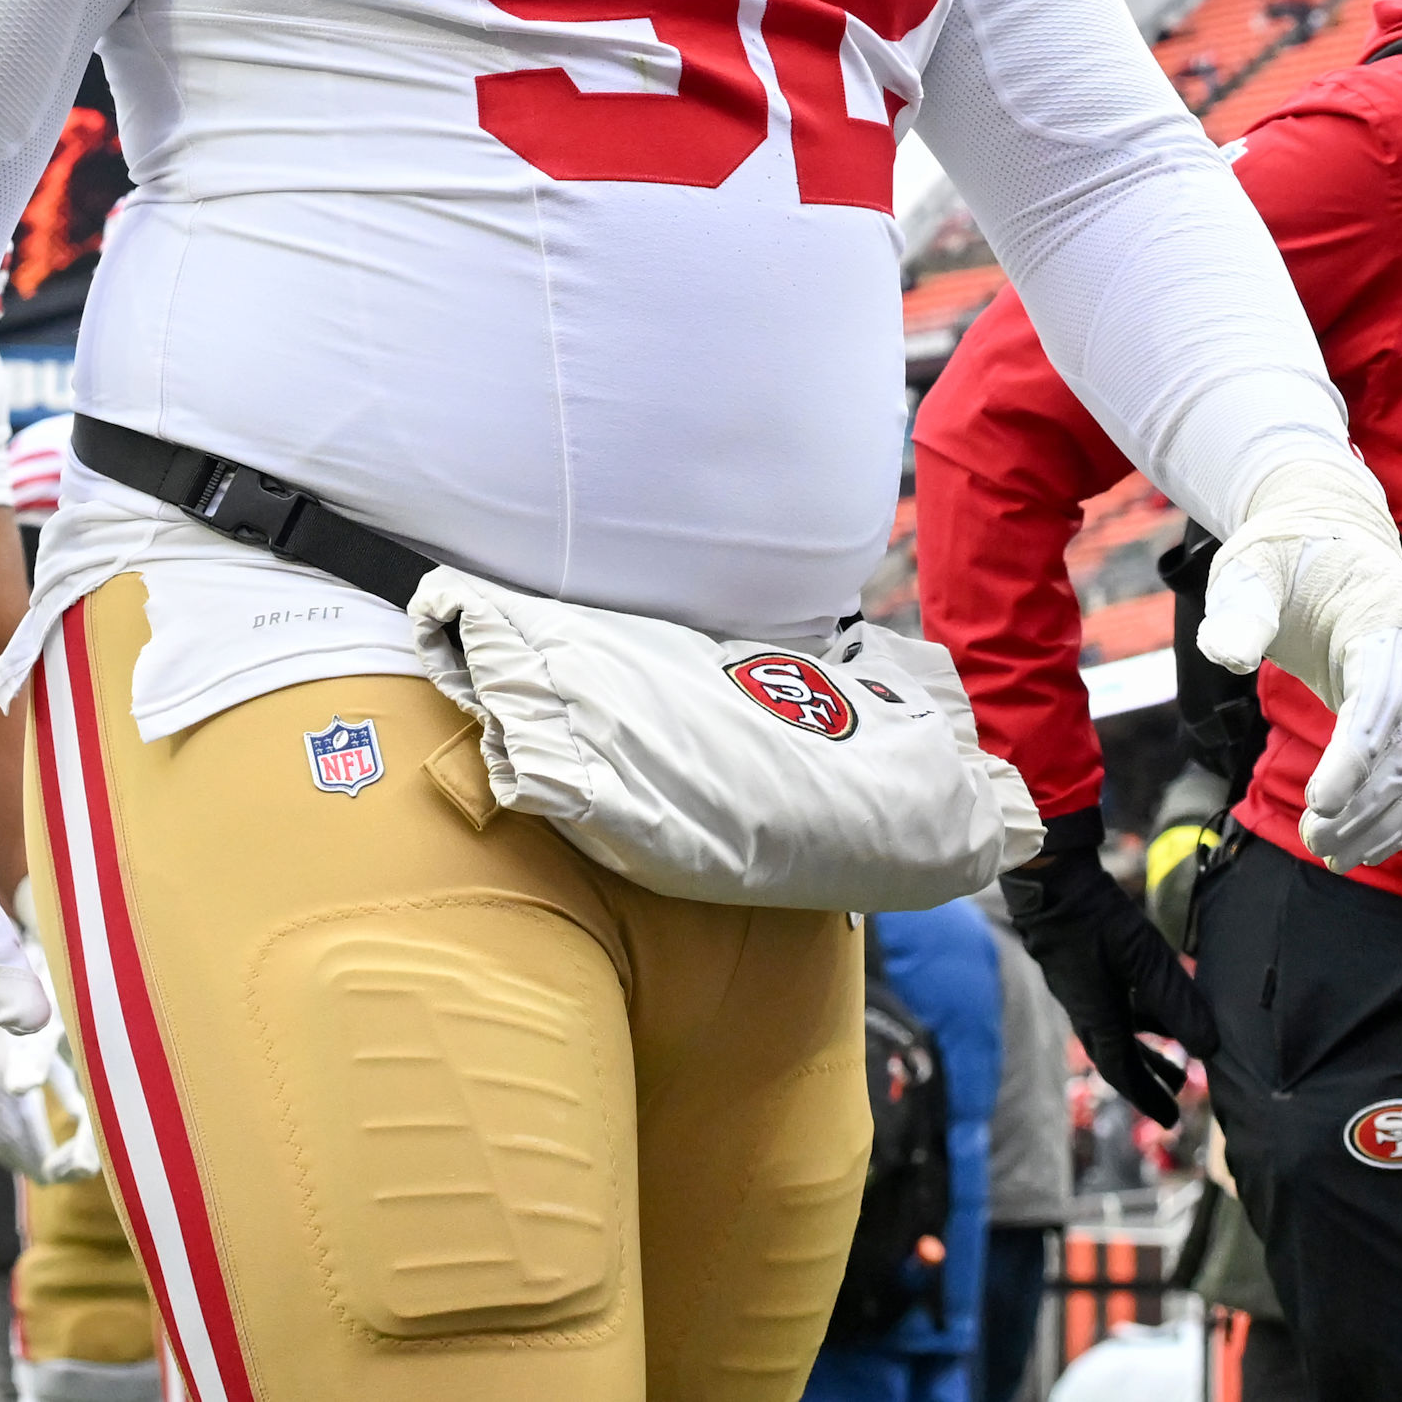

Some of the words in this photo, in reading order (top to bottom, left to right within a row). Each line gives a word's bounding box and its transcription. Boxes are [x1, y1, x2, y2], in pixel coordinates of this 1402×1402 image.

[252, 606, 344, 629] DRI-FIT
[748, 663, 841, 733] SF
[320, 749, 373, 782] NFL
